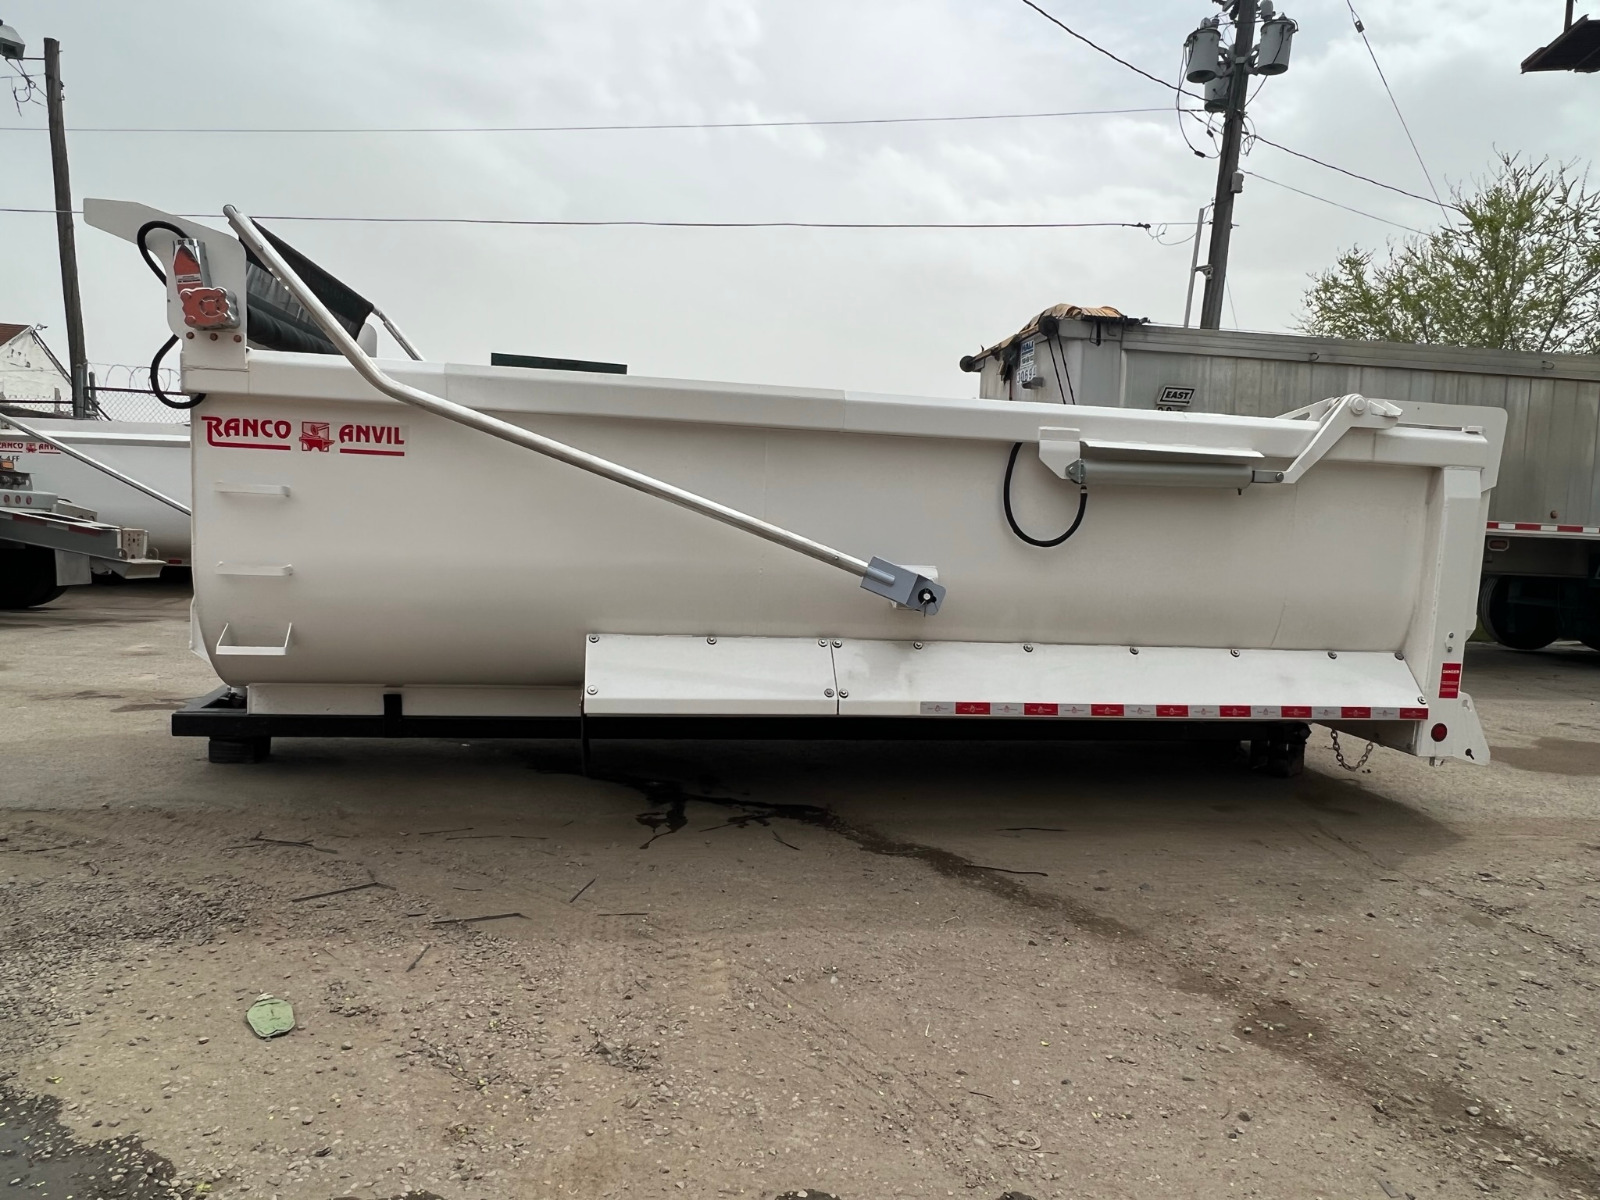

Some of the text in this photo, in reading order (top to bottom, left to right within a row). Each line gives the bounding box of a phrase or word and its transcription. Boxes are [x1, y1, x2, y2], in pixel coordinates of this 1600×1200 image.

[1165, 390, 1190, 400] EAST
[201, 416, 405, 445] RANCO ANVIL
